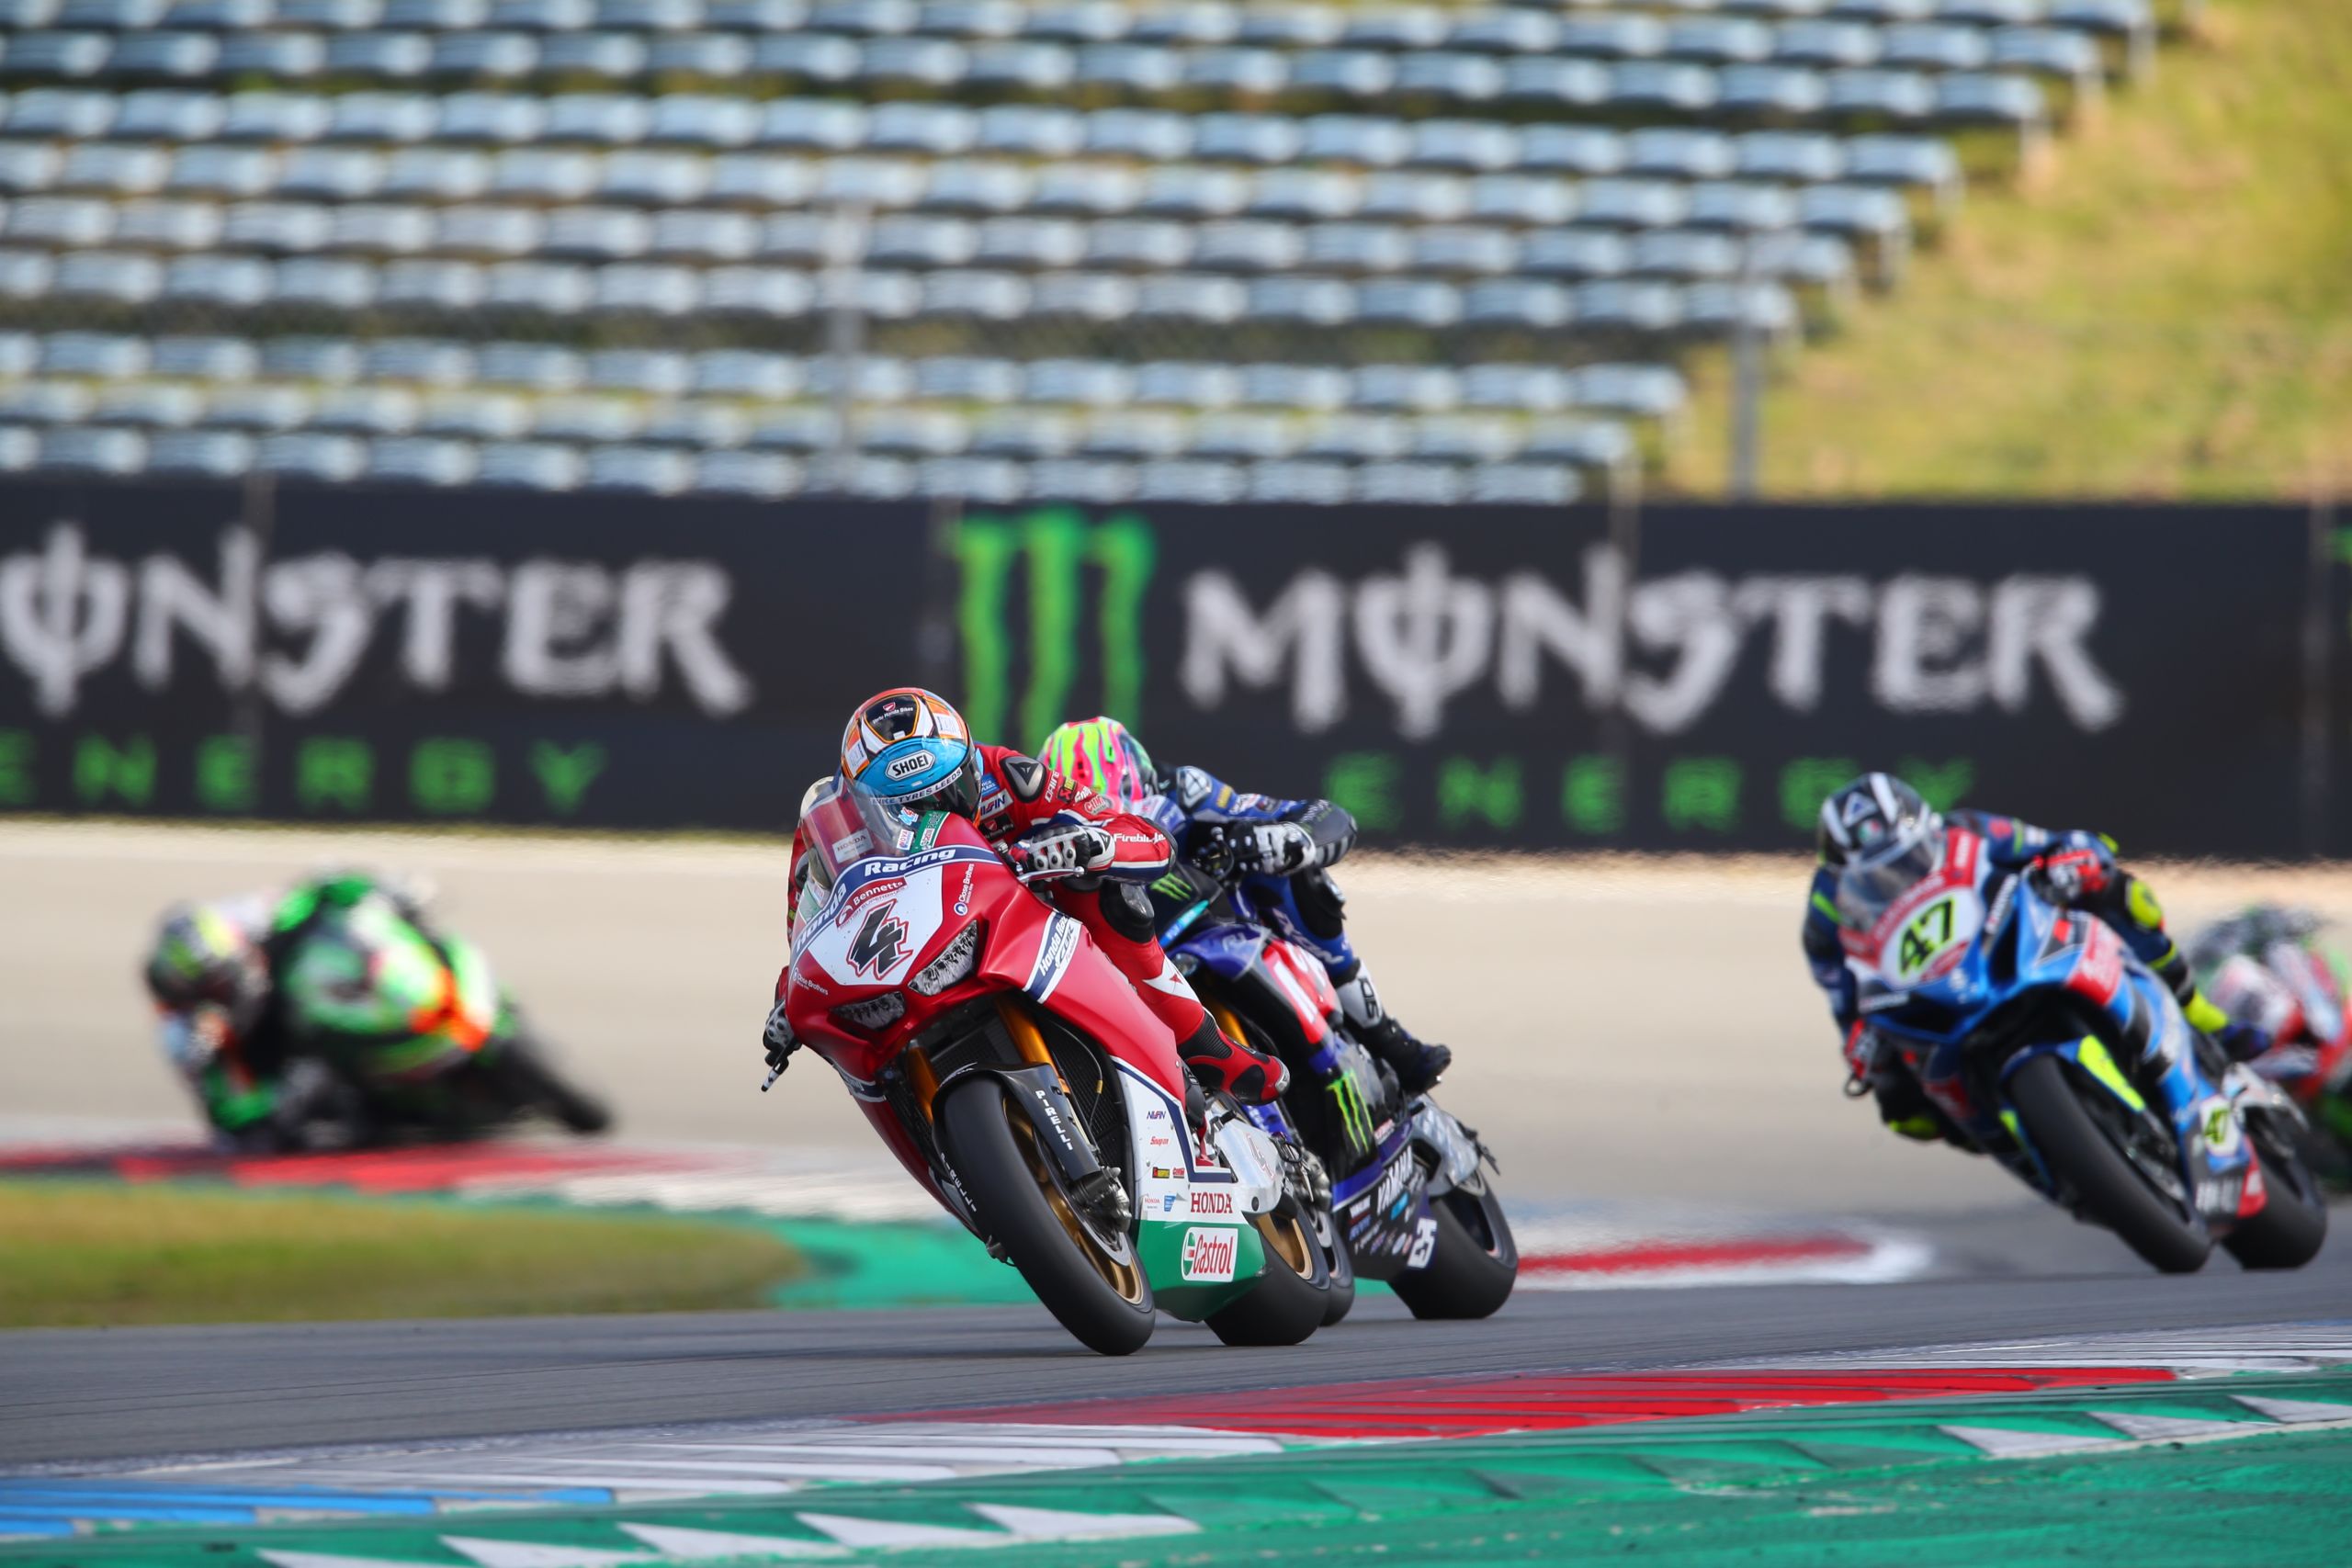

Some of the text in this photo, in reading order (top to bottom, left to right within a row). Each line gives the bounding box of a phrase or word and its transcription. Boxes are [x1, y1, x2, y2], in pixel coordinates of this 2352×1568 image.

[1181, 544, 2121, 738] MONSTER
[892, 754, 929, 777] SHOEI
[899, 788, 933, 803] TYRES
[935, 770, 962, 791] LEEDS
[796, 849, 956, 954] Honda Racing
[853, 880, 903, 907] Bennetts
[958, 878, 969, 902] Close
[964, 863, 975, 885] Brothers
[846, 897, 914, 981] 4
[1039, 933, 1061, 976] Honda
[1900, 894, 1955, 978] 47
[1035, 1089, 1073, 1151] PIRELLI
[940, 1152, 977, 1213] PIRELLI
[1191, 1192, 1233, 1213] HONDA
[1193, 1234, 1234, 1274] Castrol
